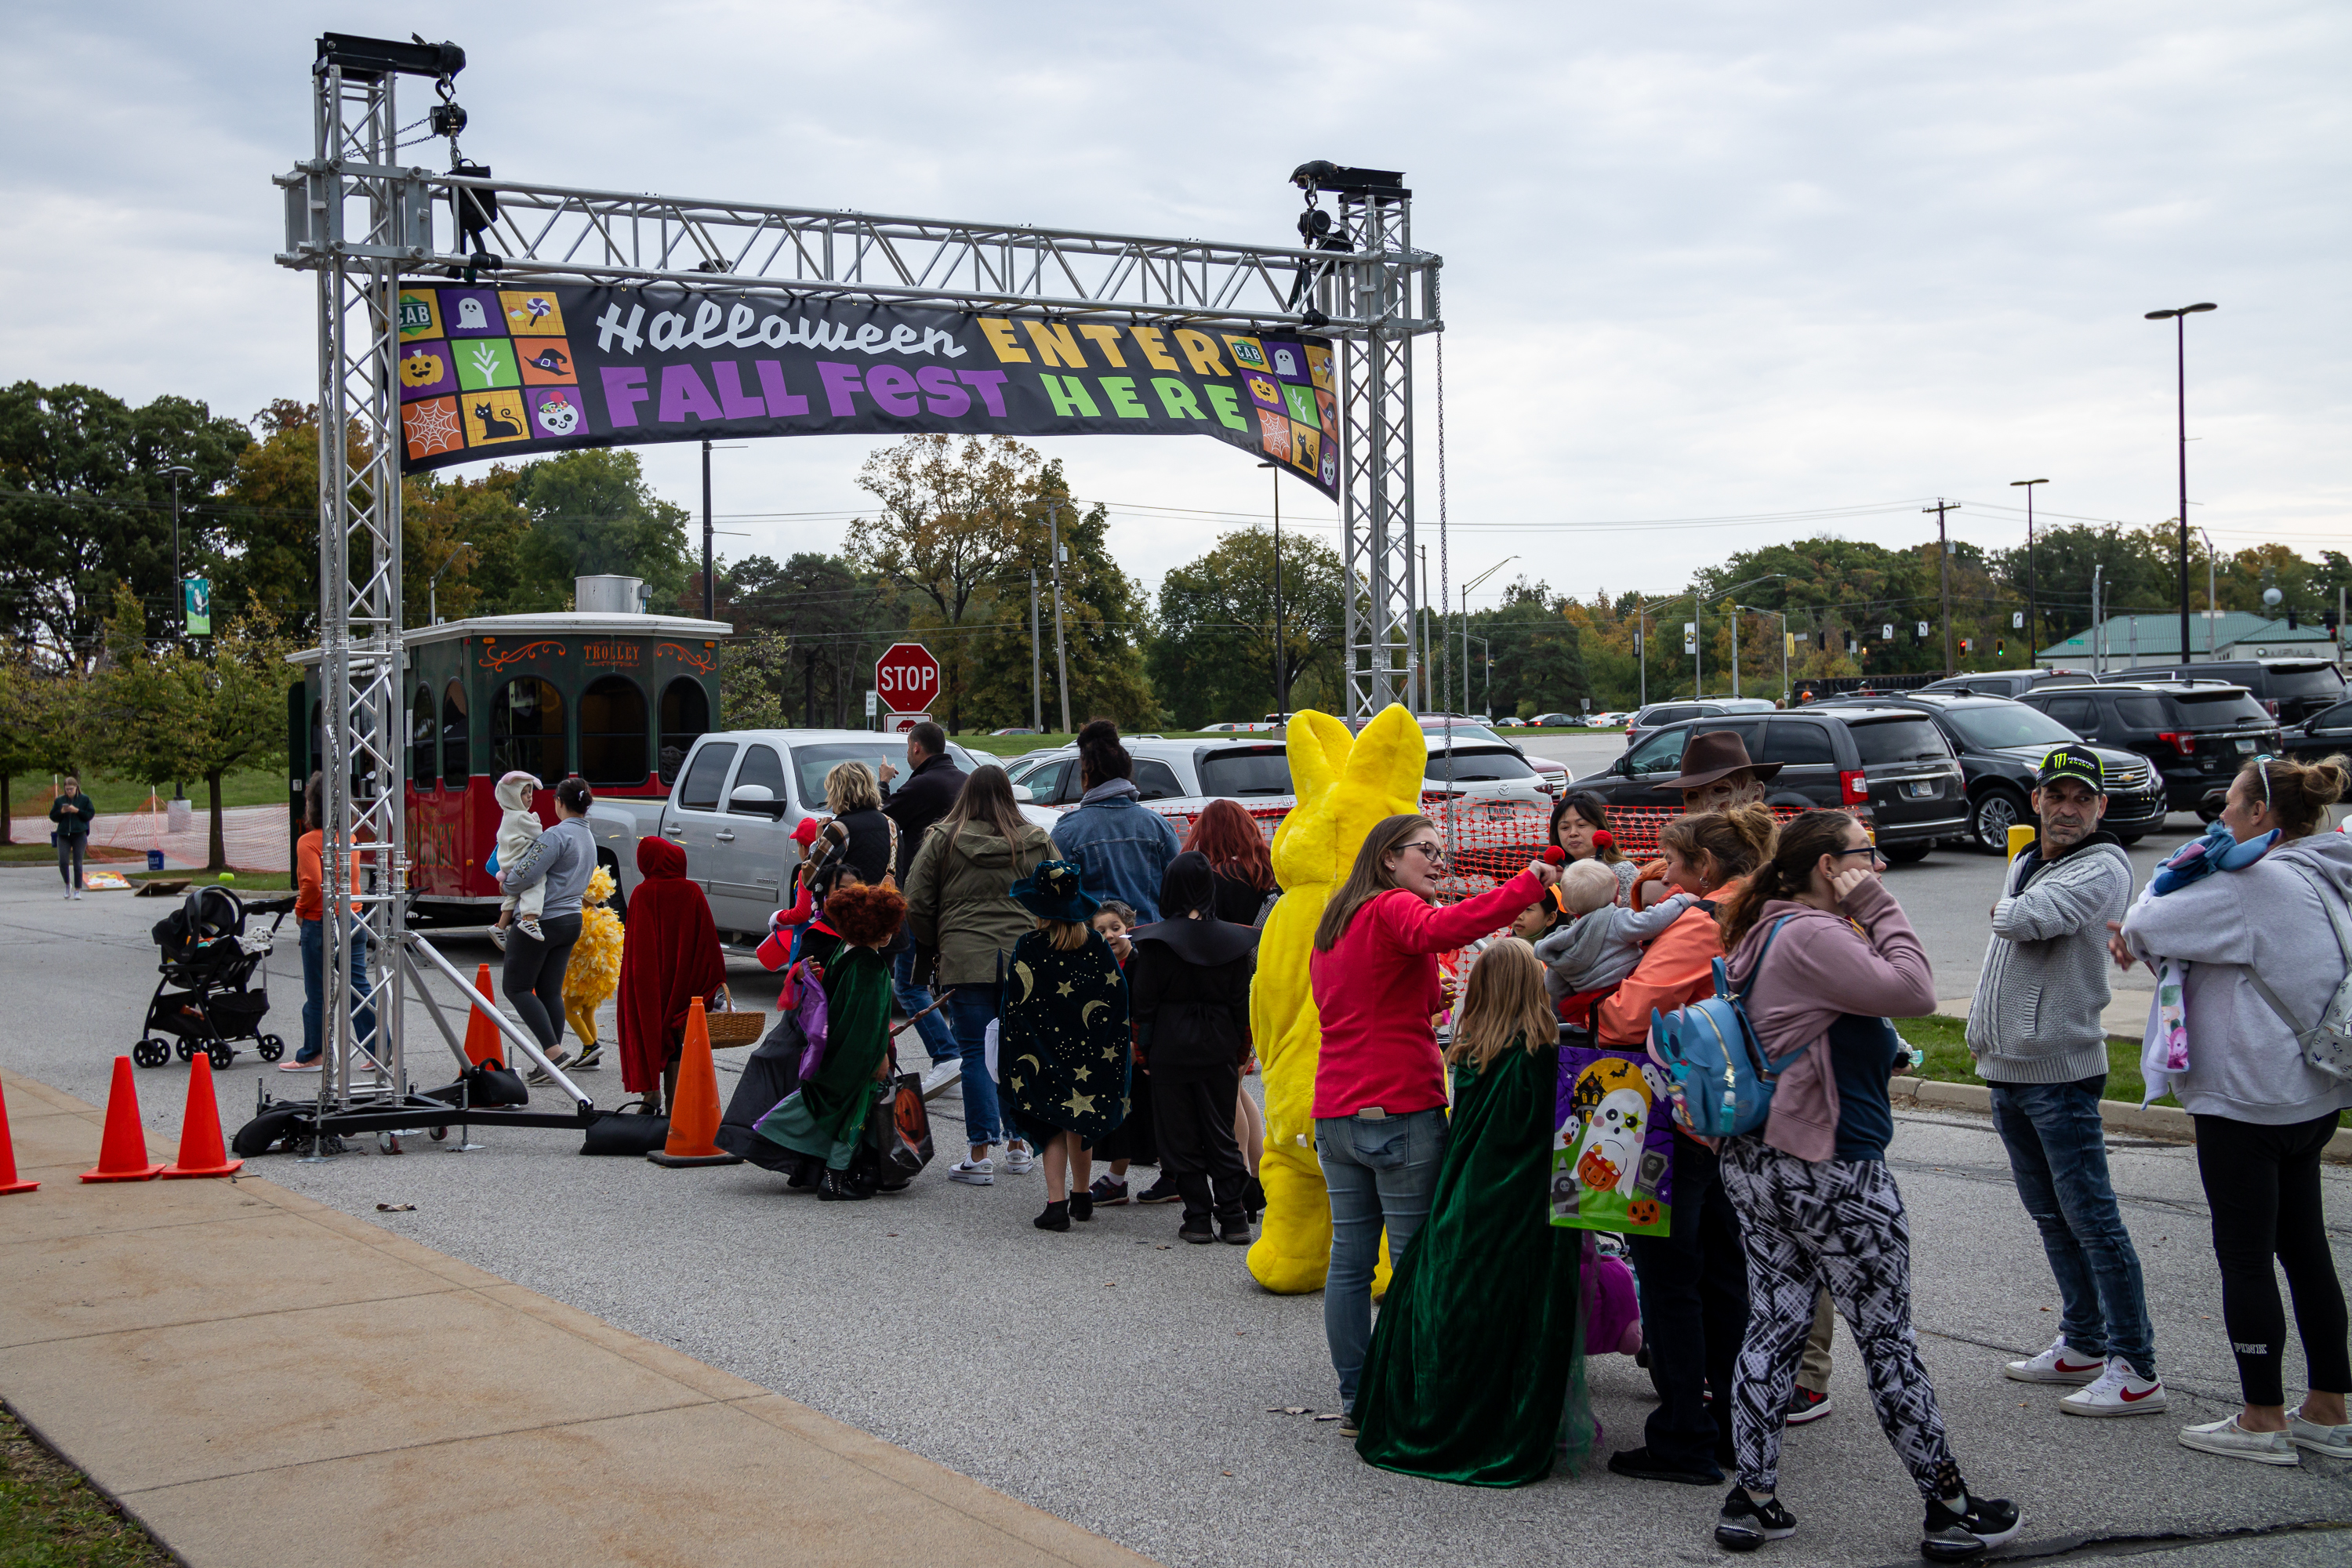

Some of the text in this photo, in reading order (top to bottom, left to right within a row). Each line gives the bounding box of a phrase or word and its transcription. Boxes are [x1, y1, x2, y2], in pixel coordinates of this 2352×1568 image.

[596, 299, 967, 358] Halloween
[977, 318, 1232, 376] ENTER
[1235, 346, 1261, 360] CAB
[599, 360, 810, 428] FALL
[1040, 373, 1248, 433] HERE
[583, 644, 640, 660] TROLLEY
[881, 666, 935, 691] STOP
[2234, 1342, 2267, 1354] PINK
